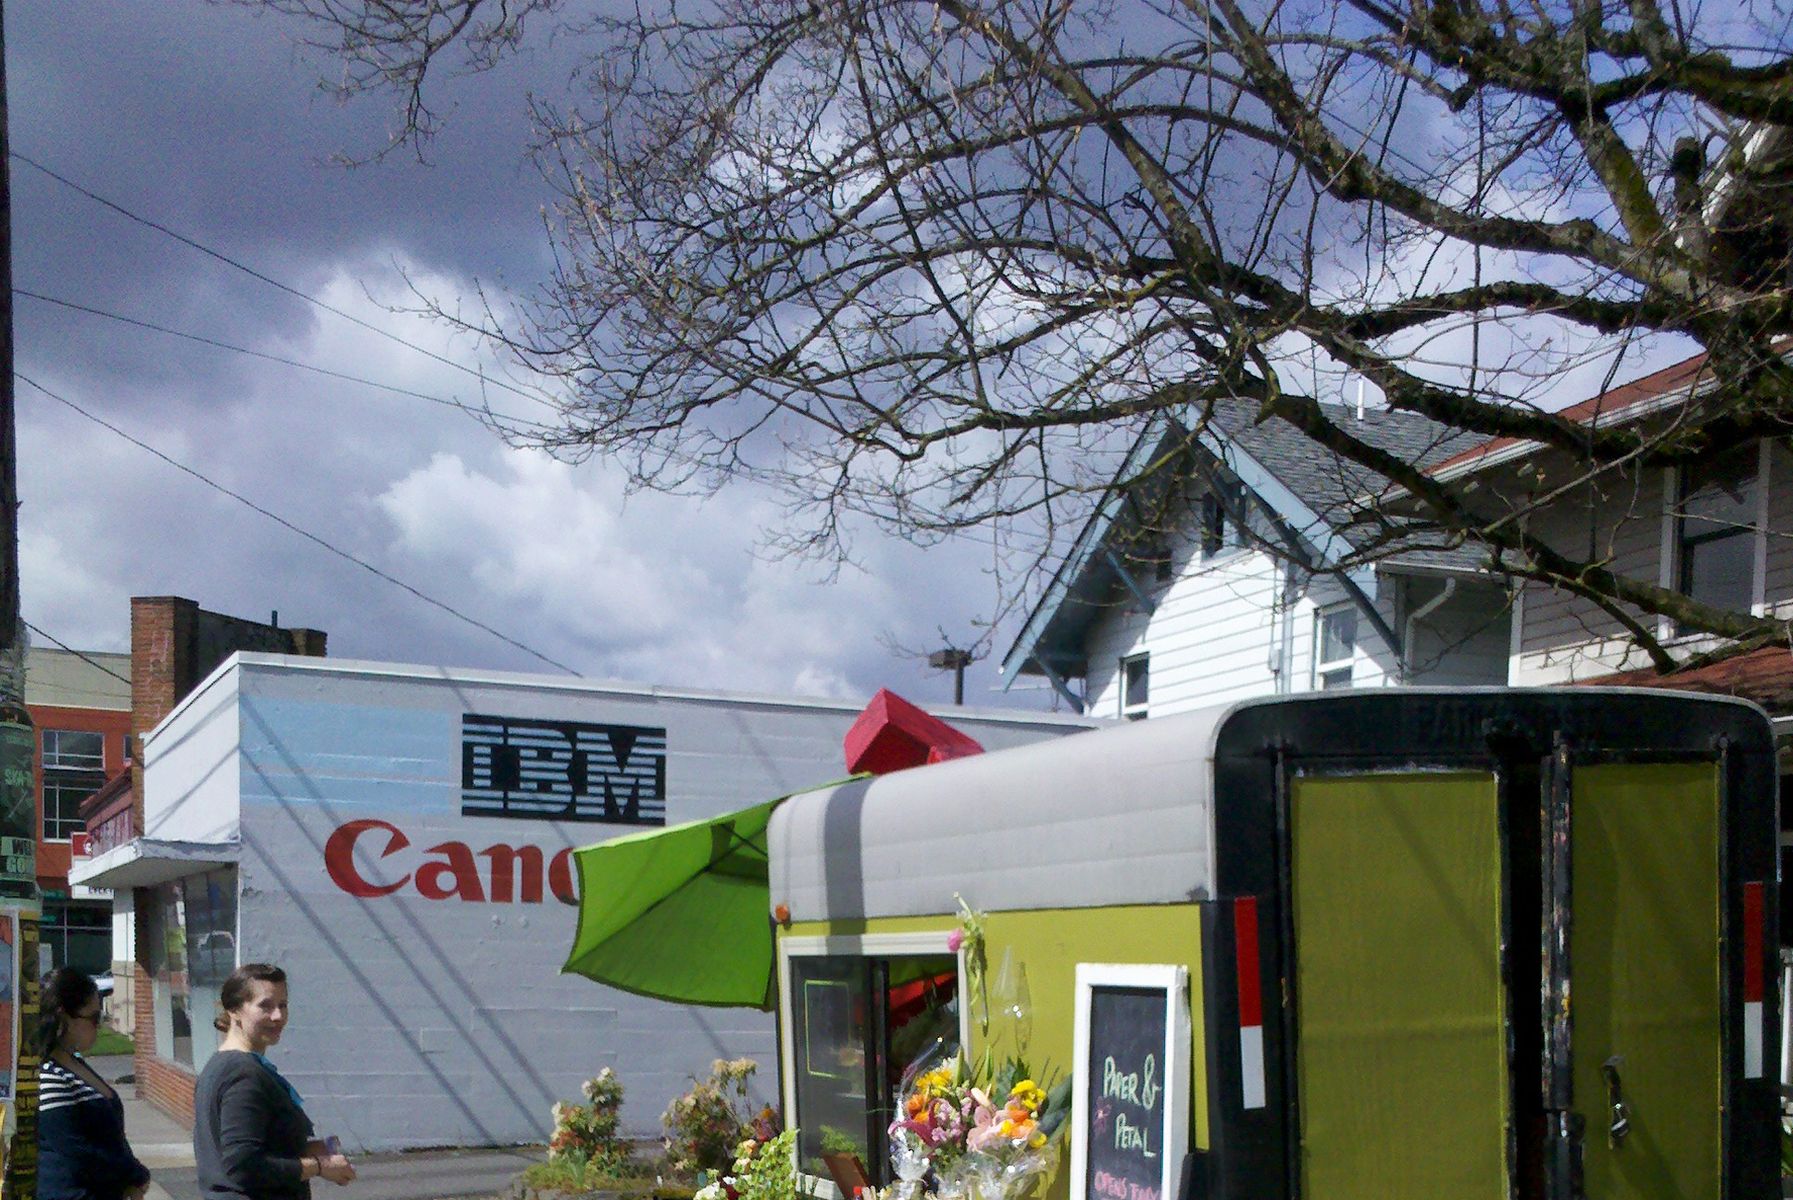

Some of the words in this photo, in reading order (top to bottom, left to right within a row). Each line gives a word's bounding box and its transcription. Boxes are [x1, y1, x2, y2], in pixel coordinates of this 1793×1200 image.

[462, 719, 666, 822] IBM
[324, 819, 579, 906] Can
[1103, 1056, 1141, 1106] PAPER
[1143, 1053, 1161, 1110] &
[1115, 1113, 1155, 1157] PETAL
